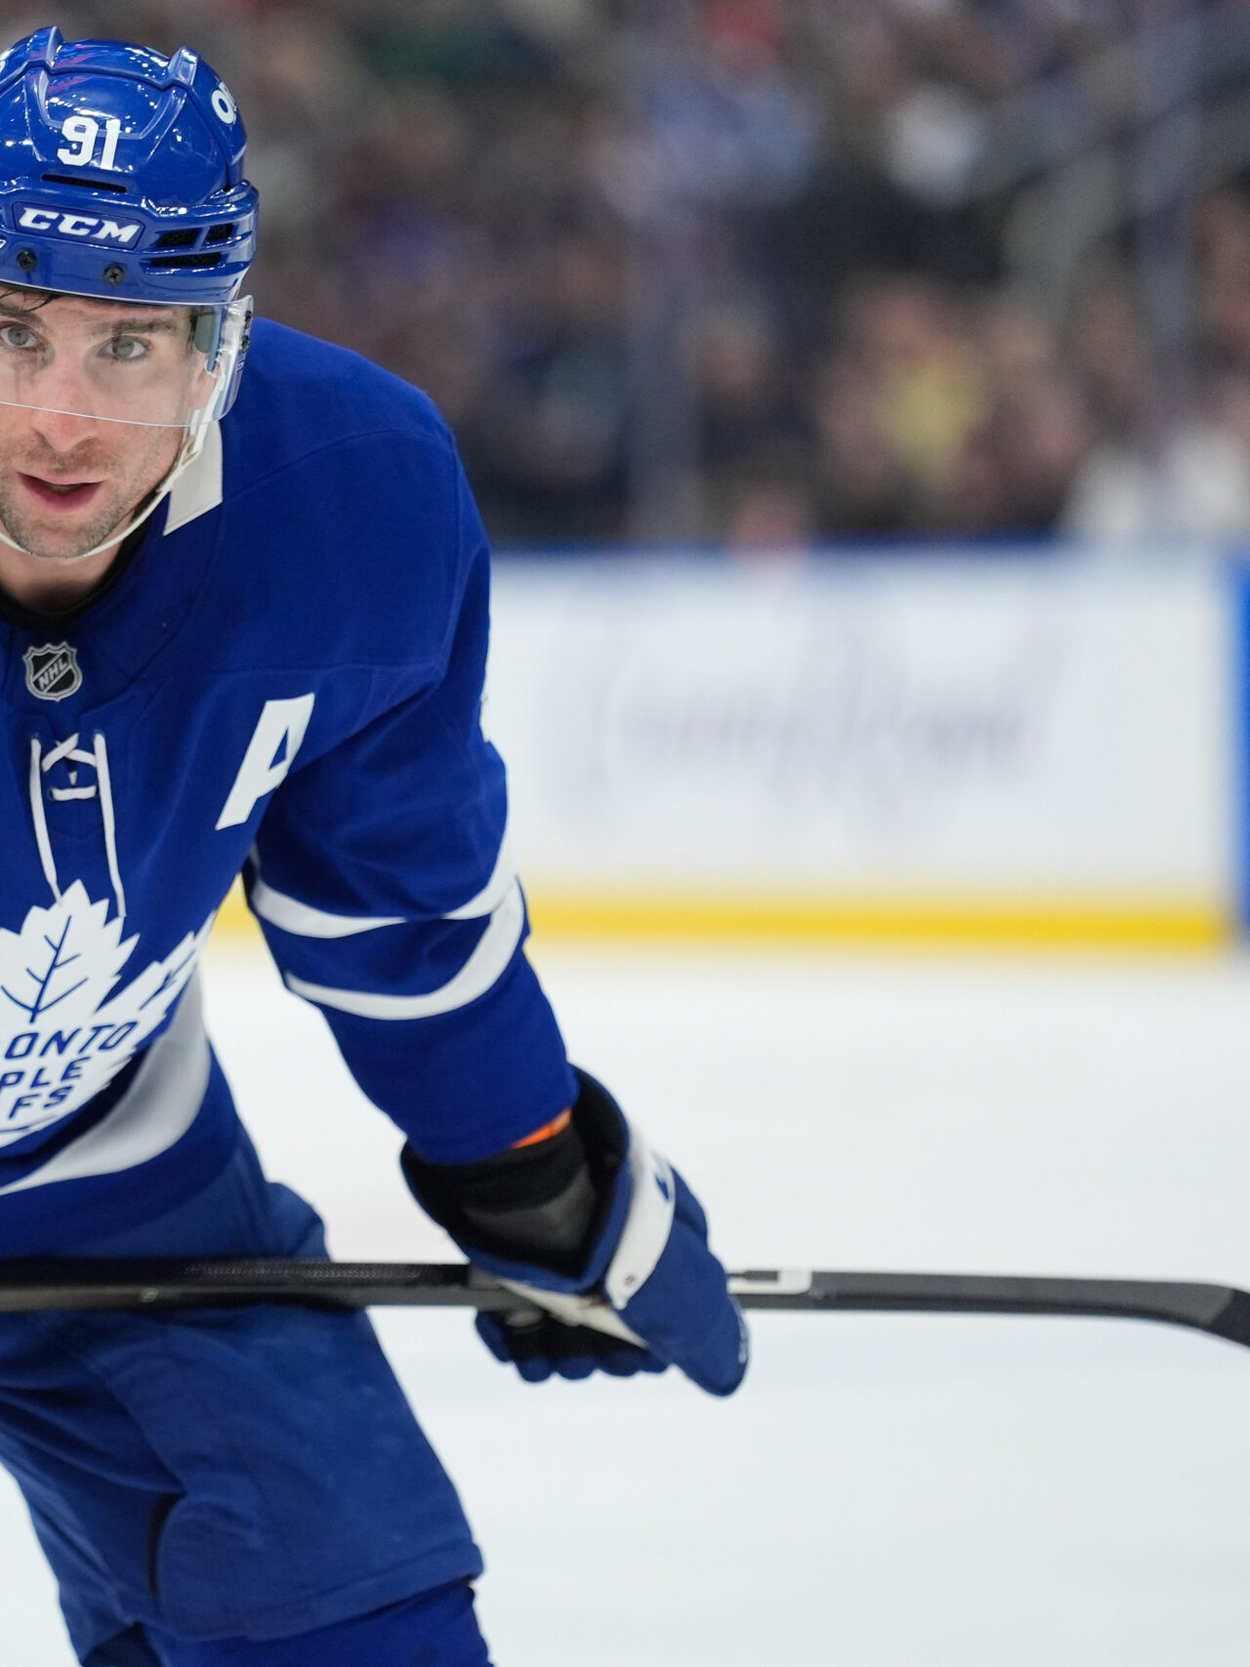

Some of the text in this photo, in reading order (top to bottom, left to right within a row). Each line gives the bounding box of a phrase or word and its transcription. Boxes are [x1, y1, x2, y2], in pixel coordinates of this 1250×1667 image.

[57, 115, 121, 170] 91
[18, 207, 142, 243] CCM
[38, 657, 69, 690] NHL
[214, 692, 315, 831] A
